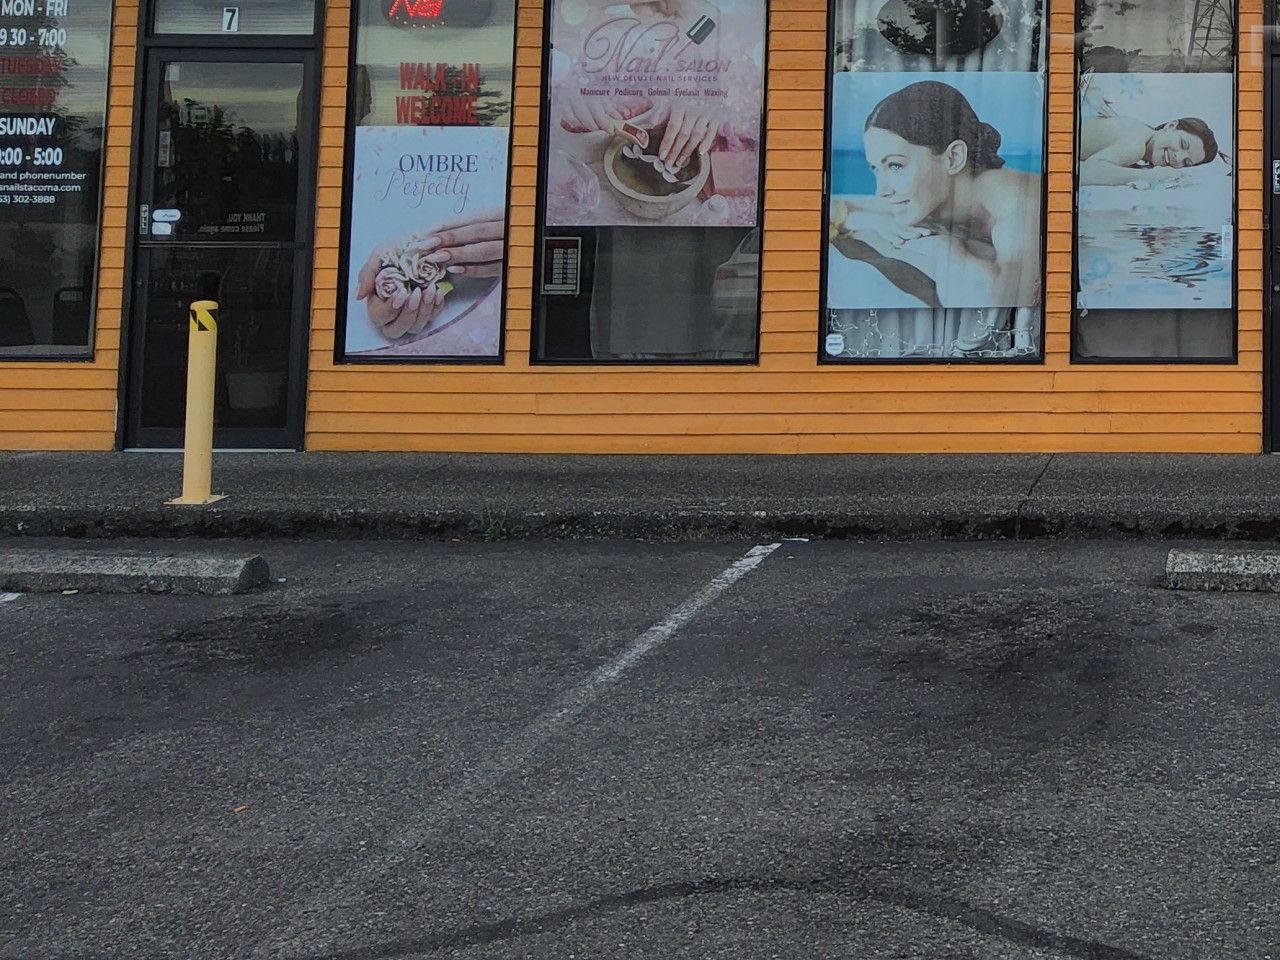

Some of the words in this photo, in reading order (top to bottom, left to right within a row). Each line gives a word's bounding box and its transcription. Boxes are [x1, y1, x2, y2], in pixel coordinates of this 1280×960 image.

[225, 8, 237, 31] 7
[38, 27, 67, 46] 7:00
[677, 58, 732, 74] SALON
[400, 62, 449, 90] WALK
[460, 62, 481, 92] IN
[580, 87, 610, 97] Manicure
[704, 87, 728, 98] Waxing
[396, 95, 478, 124] WELCOME
[0, 117, 56, 135] SUNDAY
[33, 147, 63, 165] 5:00
[399, 153, 479, 173] OMBRE
[19, 171, 87, 181] phonenumber
[374, 167, 471, 214] Perfectly
